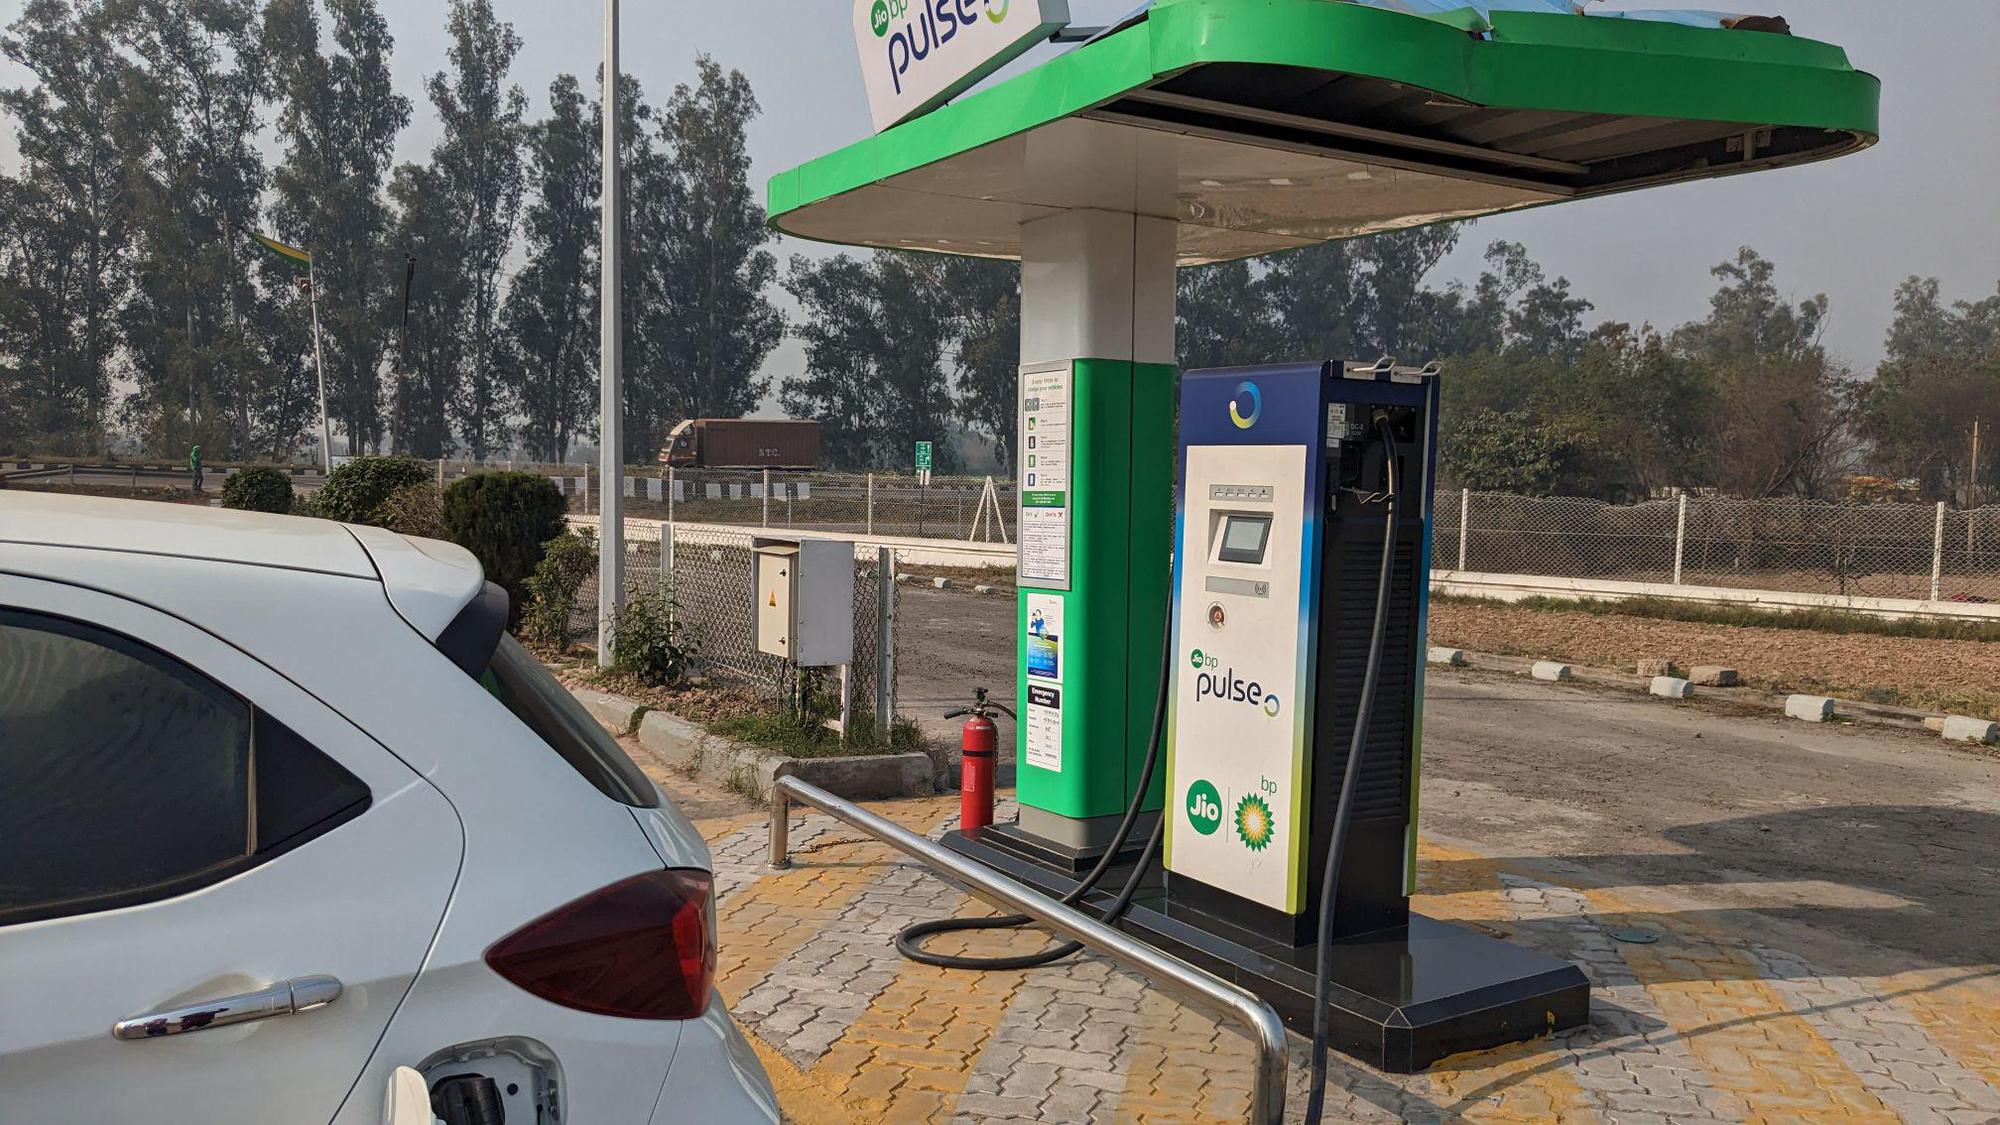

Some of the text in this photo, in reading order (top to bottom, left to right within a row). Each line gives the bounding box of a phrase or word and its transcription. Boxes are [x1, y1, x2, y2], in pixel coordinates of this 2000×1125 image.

[888, 0, 978, 95] pulse
[1205, 652, 1218, 670] bp
[1196, 667, 1262, 705] pulse
[1261, 774, 1277, 796] bp
[1190, 793, 1219, 821] Jio
